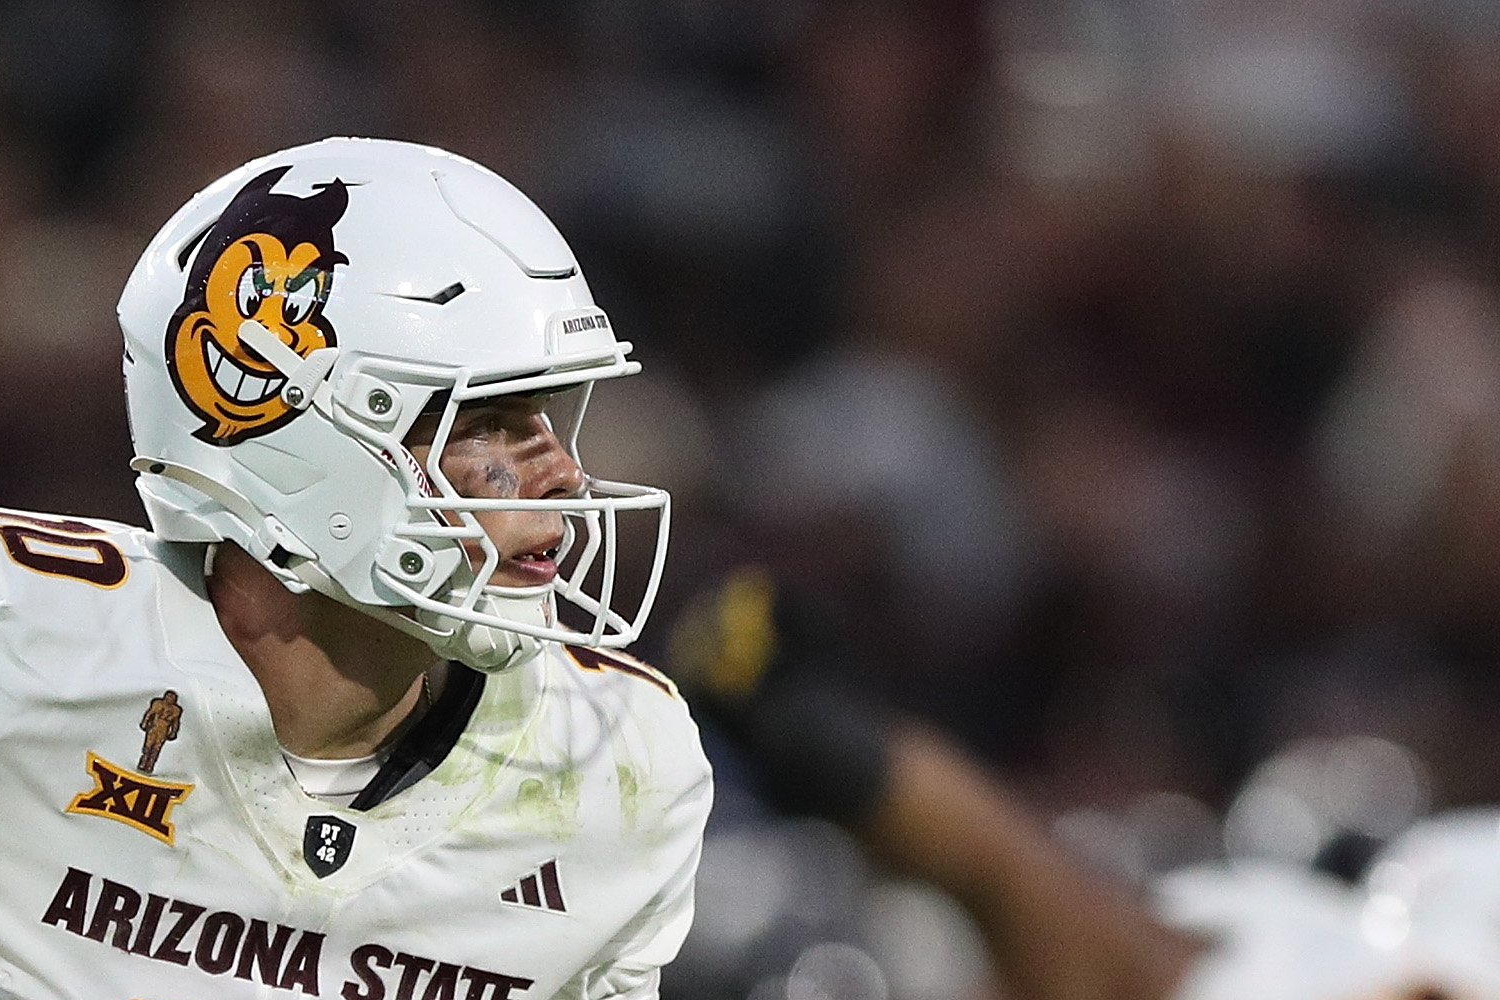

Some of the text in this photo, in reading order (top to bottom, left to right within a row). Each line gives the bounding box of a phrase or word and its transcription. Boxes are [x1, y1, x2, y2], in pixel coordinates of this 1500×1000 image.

[320, 823, 341, 841] PT
[316, 845, 336, 864] 42
[41, 866, 328, 997] ARIZONA
